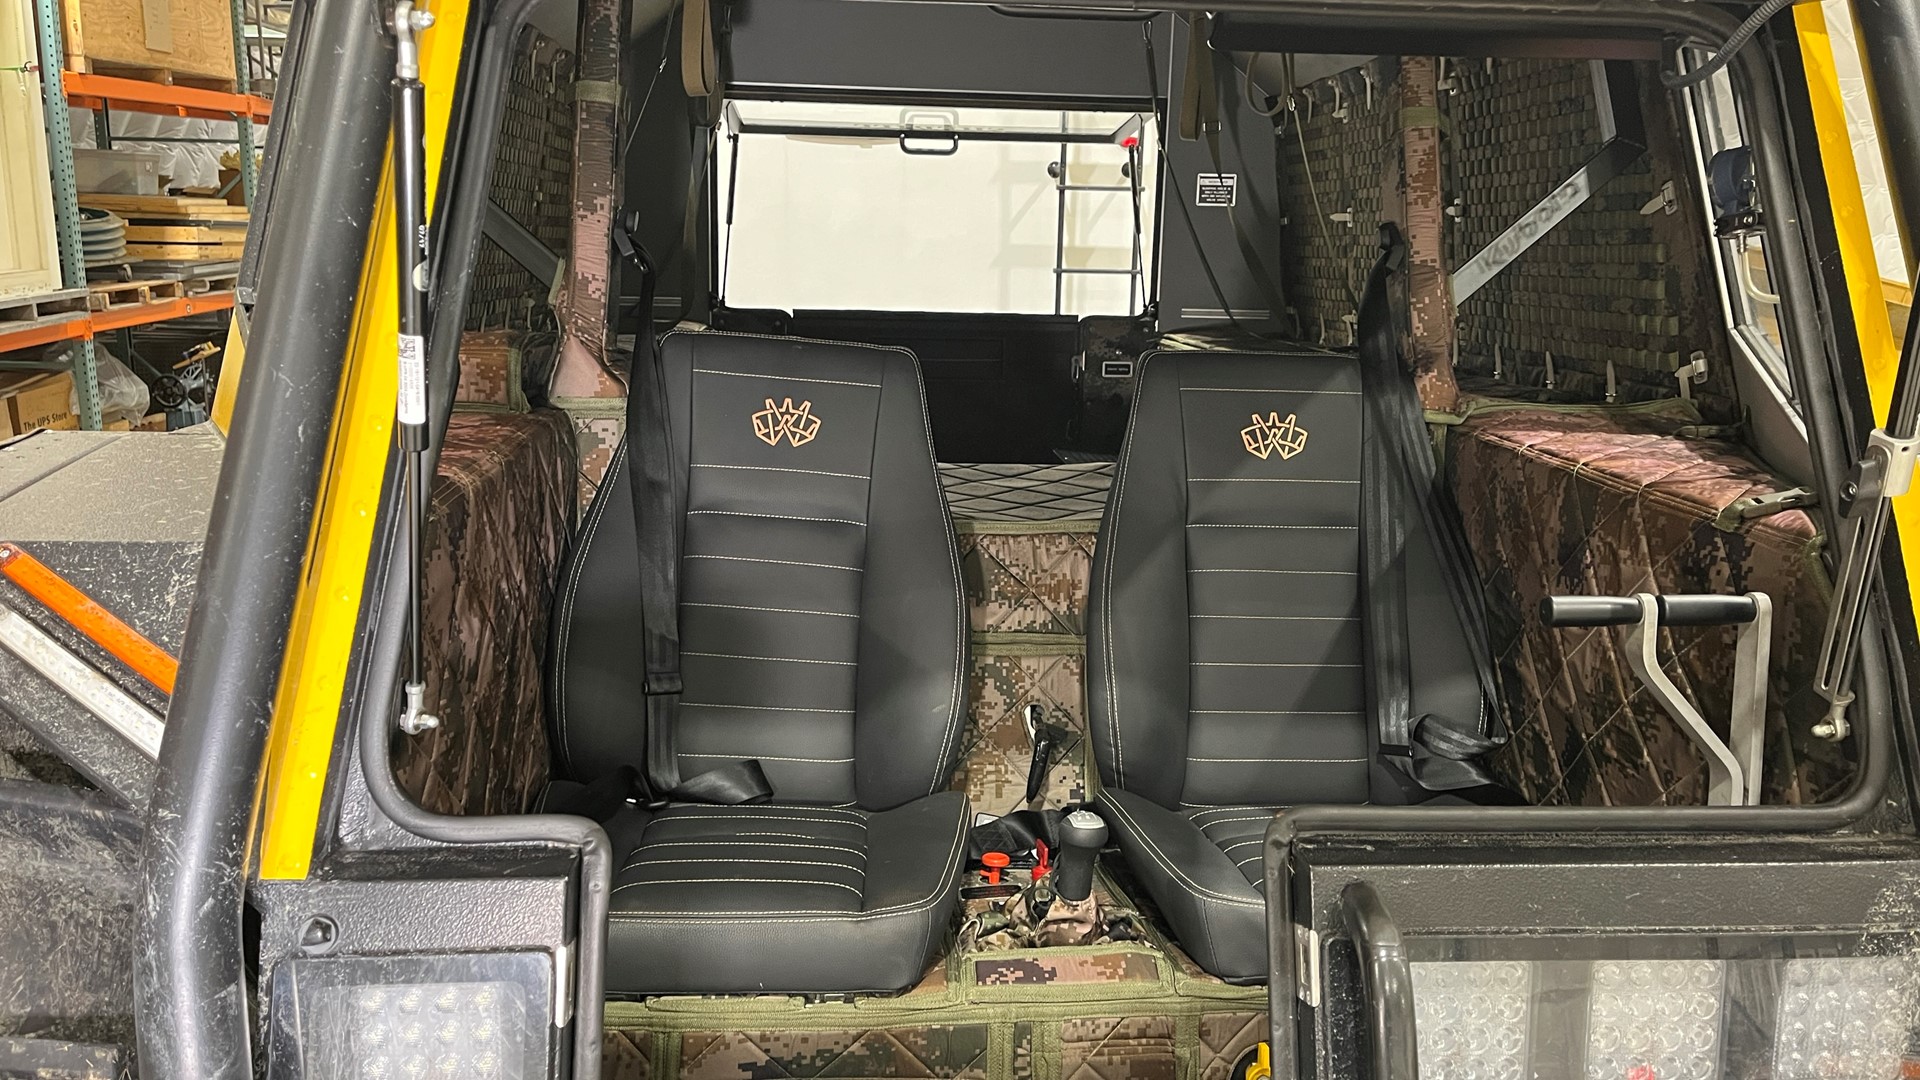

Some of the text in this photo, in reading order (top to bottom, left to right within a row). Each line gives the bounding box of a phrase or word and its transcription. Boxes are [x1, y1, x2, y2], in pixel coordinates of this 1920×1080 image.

[23, 412, 67, 431] The UPS Store
